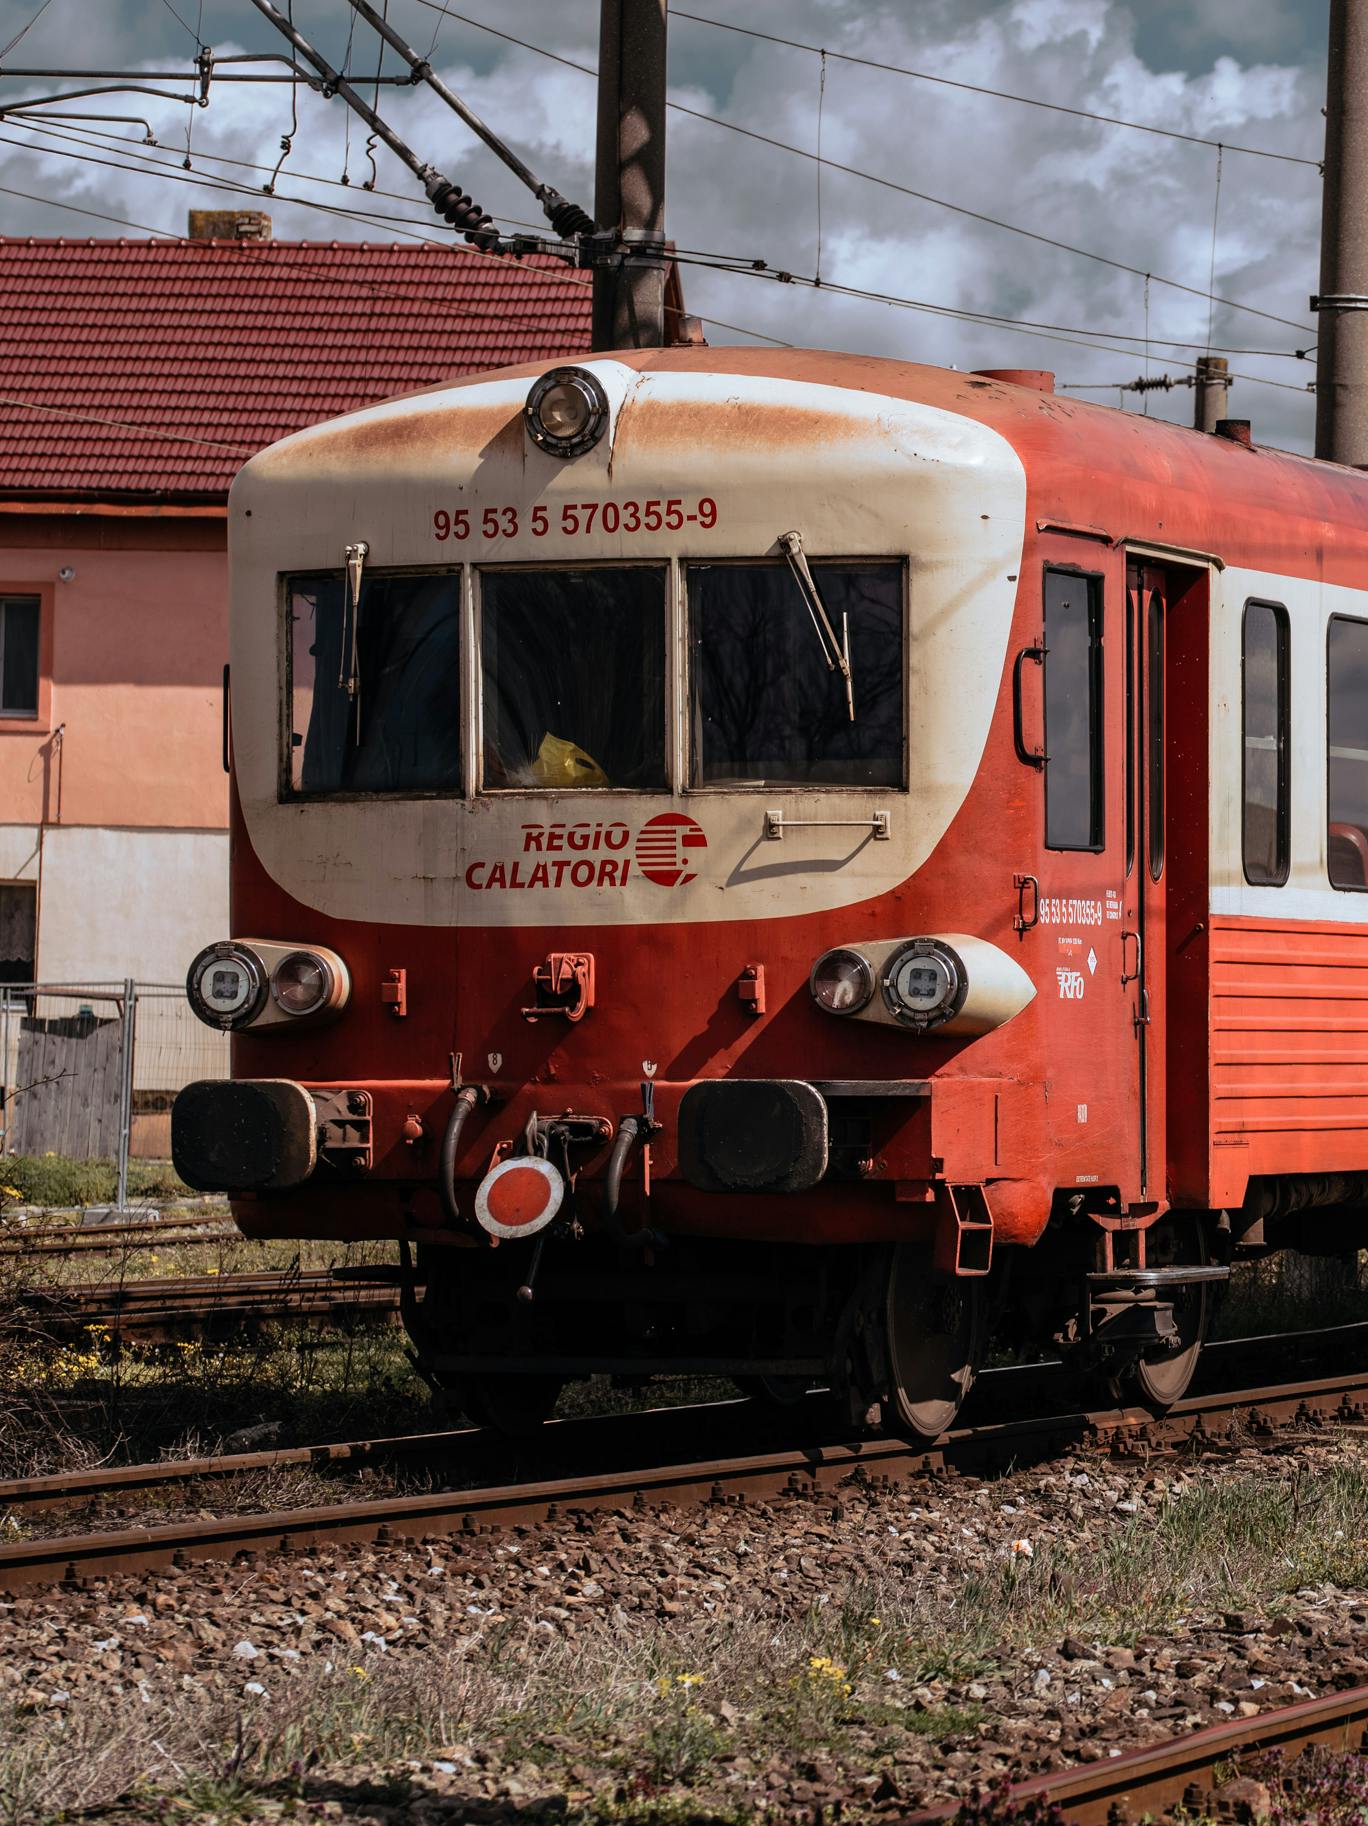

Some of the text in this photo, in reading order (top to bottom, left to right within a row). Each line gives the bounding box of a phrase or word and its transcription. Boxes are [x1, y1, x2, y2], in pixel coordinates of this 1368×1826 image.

[433, 497, 718, 541] 95 53 5 570355-9
[521, 822, 630, 852] REGIO
[1039, 898, 1102, 926] 95 53 5 570355-9
